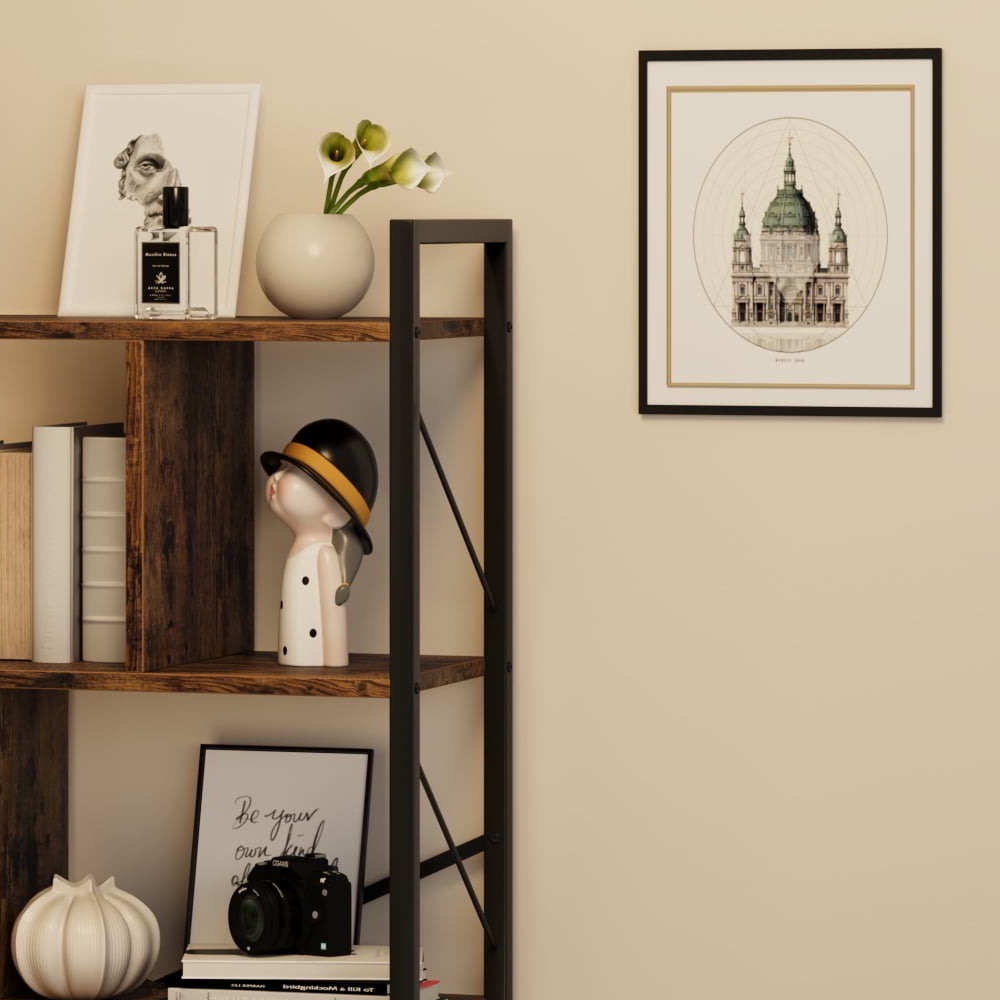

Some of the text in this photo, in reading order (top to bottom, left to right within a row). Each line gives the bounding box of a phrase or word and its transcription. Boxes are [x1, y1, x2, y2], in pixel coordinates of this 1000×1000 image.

[232, 795, 319, 842] Be your
[234, 819, 325, 861] own kind
